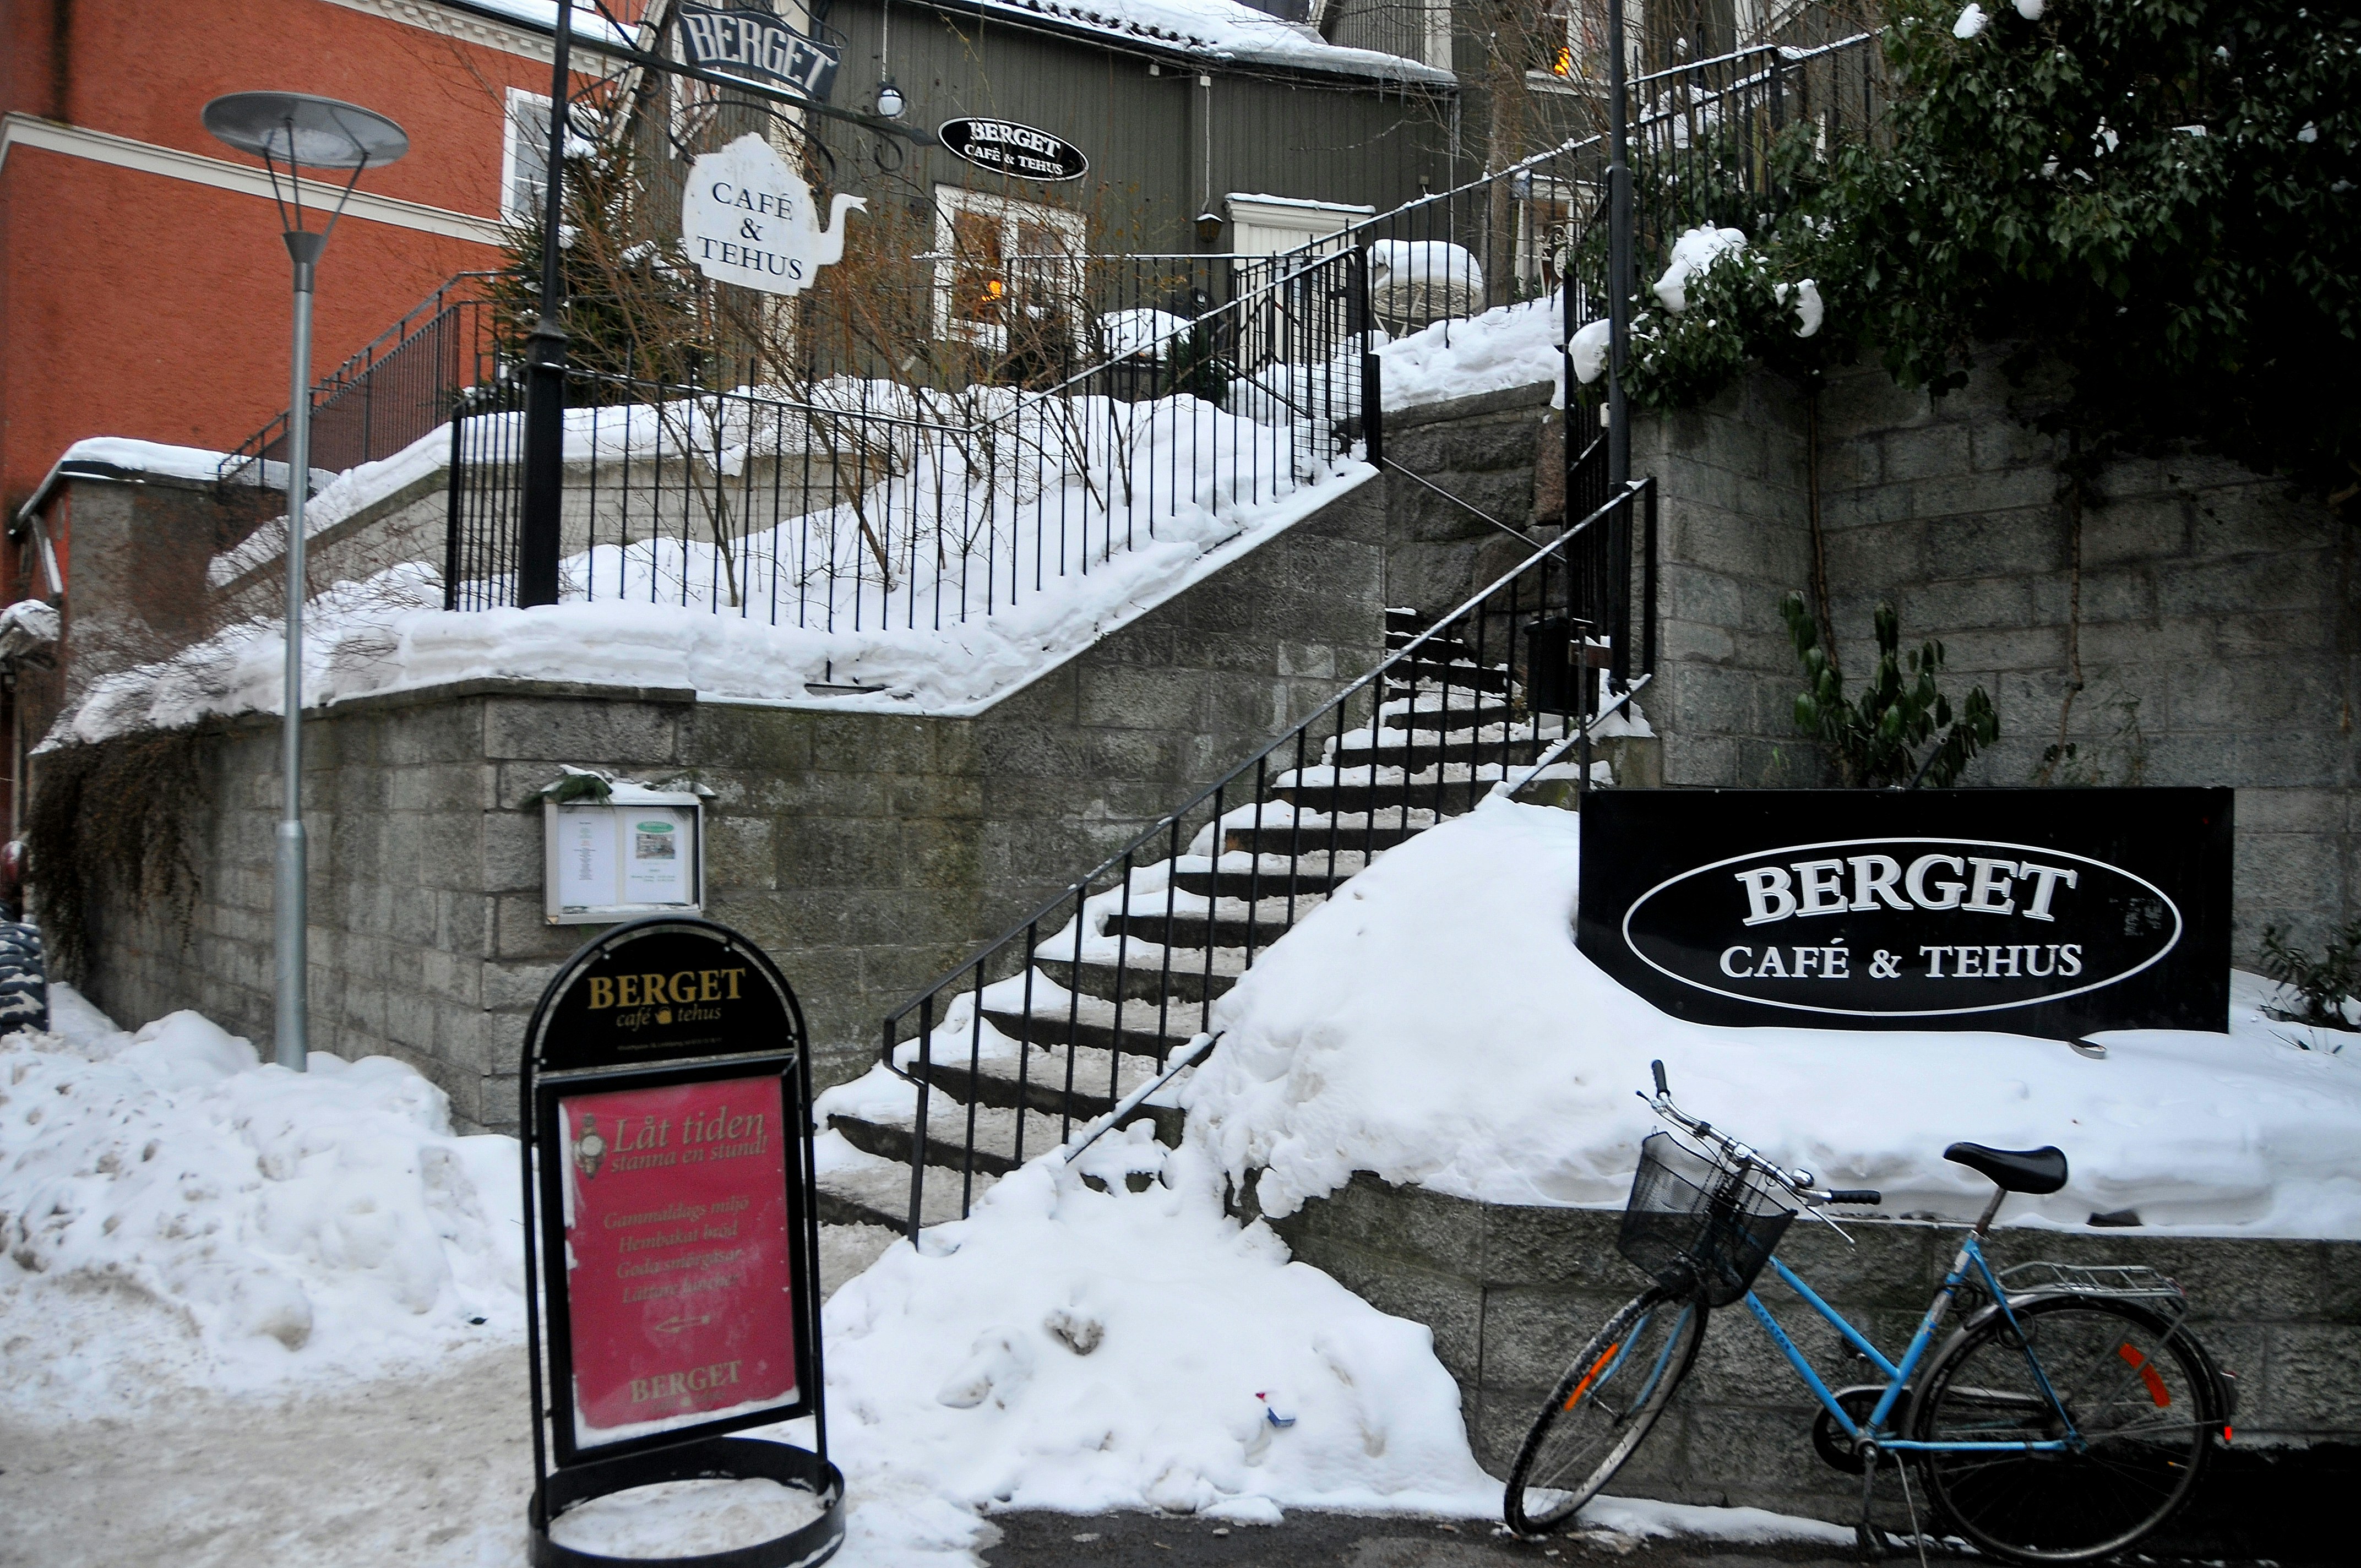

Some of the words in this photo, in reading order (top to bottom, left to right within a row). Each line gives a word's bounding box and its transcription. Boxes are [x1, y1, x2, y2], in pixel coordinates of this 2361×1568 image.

[684, 13, 839, 93] BERGET
[964, 144, 1001, 162] CAFÉ
[1004, 153, 1015, 165] &
[1018, 155, 1063, 175] TEHUS
[967, 122, 1060, 157] BERGET
[712, 182, 793, 221] CAFÉ
[741, 218, 763, 241] &
[698, 236, 803, 280] TEHUS
[1734, 854, 2078, 926] BERGET
[1719, 938, 1850, 979] CAFÉ
[1868, 949, 1902, 978] &
[1919, 943, 2083, 978] TEHUS
[587, 967, 747, 1009] BERGET
[616, 1006, 652, 1032] café
[677, 1003, 722, 1022] tehus
[611, 1115, 672, 1153] Låt
[682, 1105, 765, 1145] tiden
[611, 1151, 677, 1173] stanna
[682, 1148, 705, 1164] en
[603, 1200, 707, 1231] Gammaldags
[630, 1360, 742, 1403] BERGET
